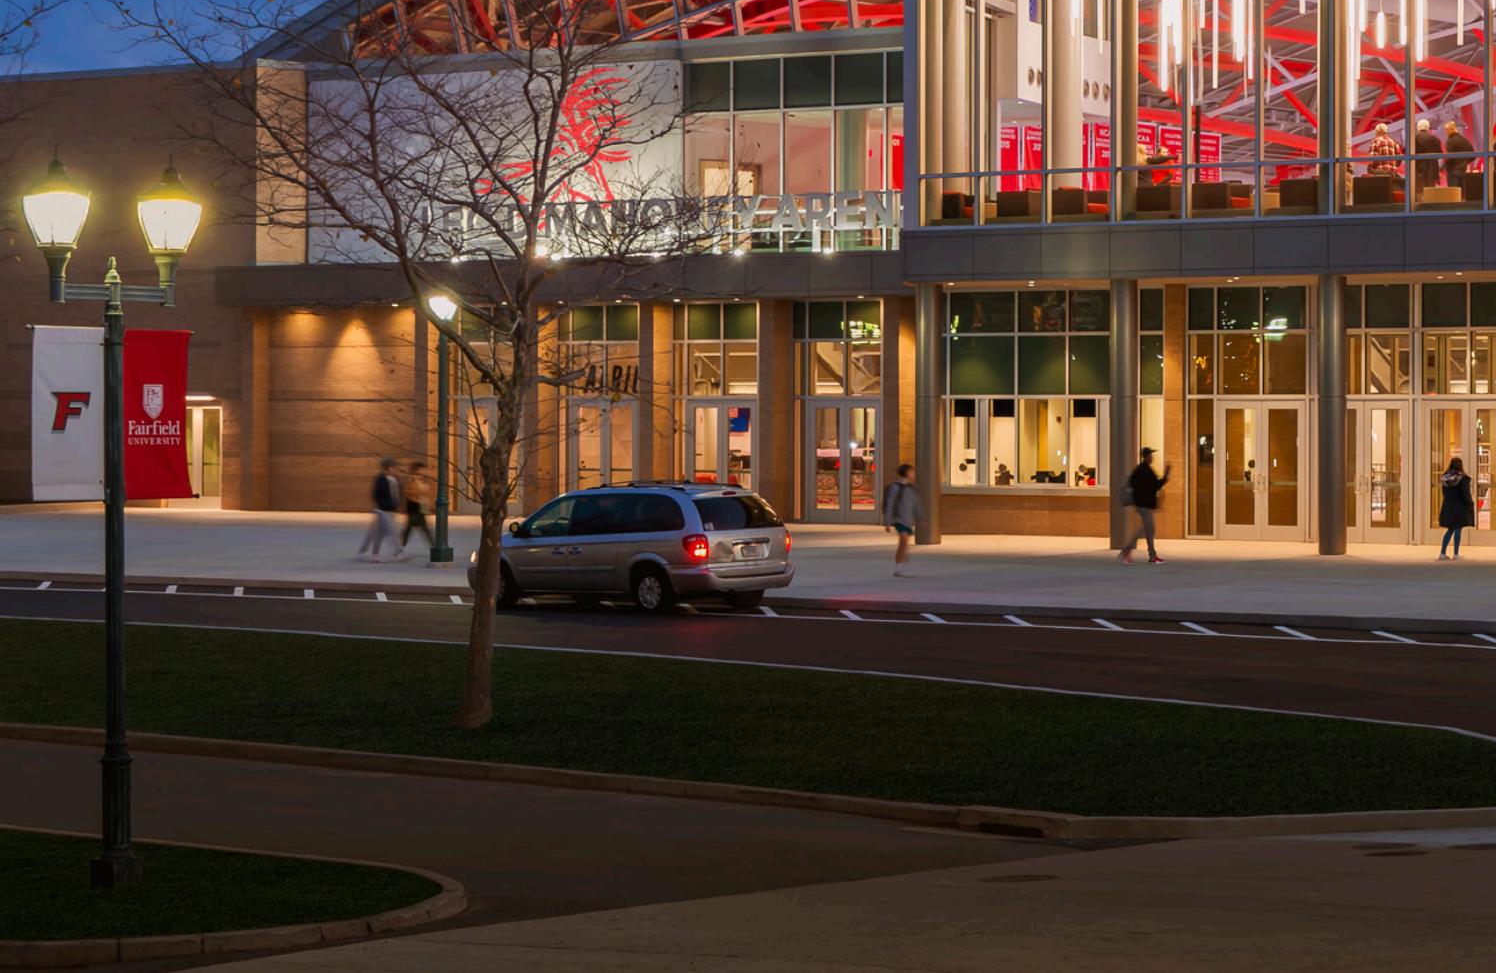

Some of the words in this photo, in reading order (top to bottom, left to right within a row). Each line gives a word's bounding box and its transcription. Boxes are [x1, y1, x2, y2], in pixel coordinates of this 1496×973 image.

[771, 190, 904, 232] AREN
[51, 392, 91, 433] F
[128, 420, 181, 436] Fairfield
[128, 437, 181, 446] UNIVERSITY
